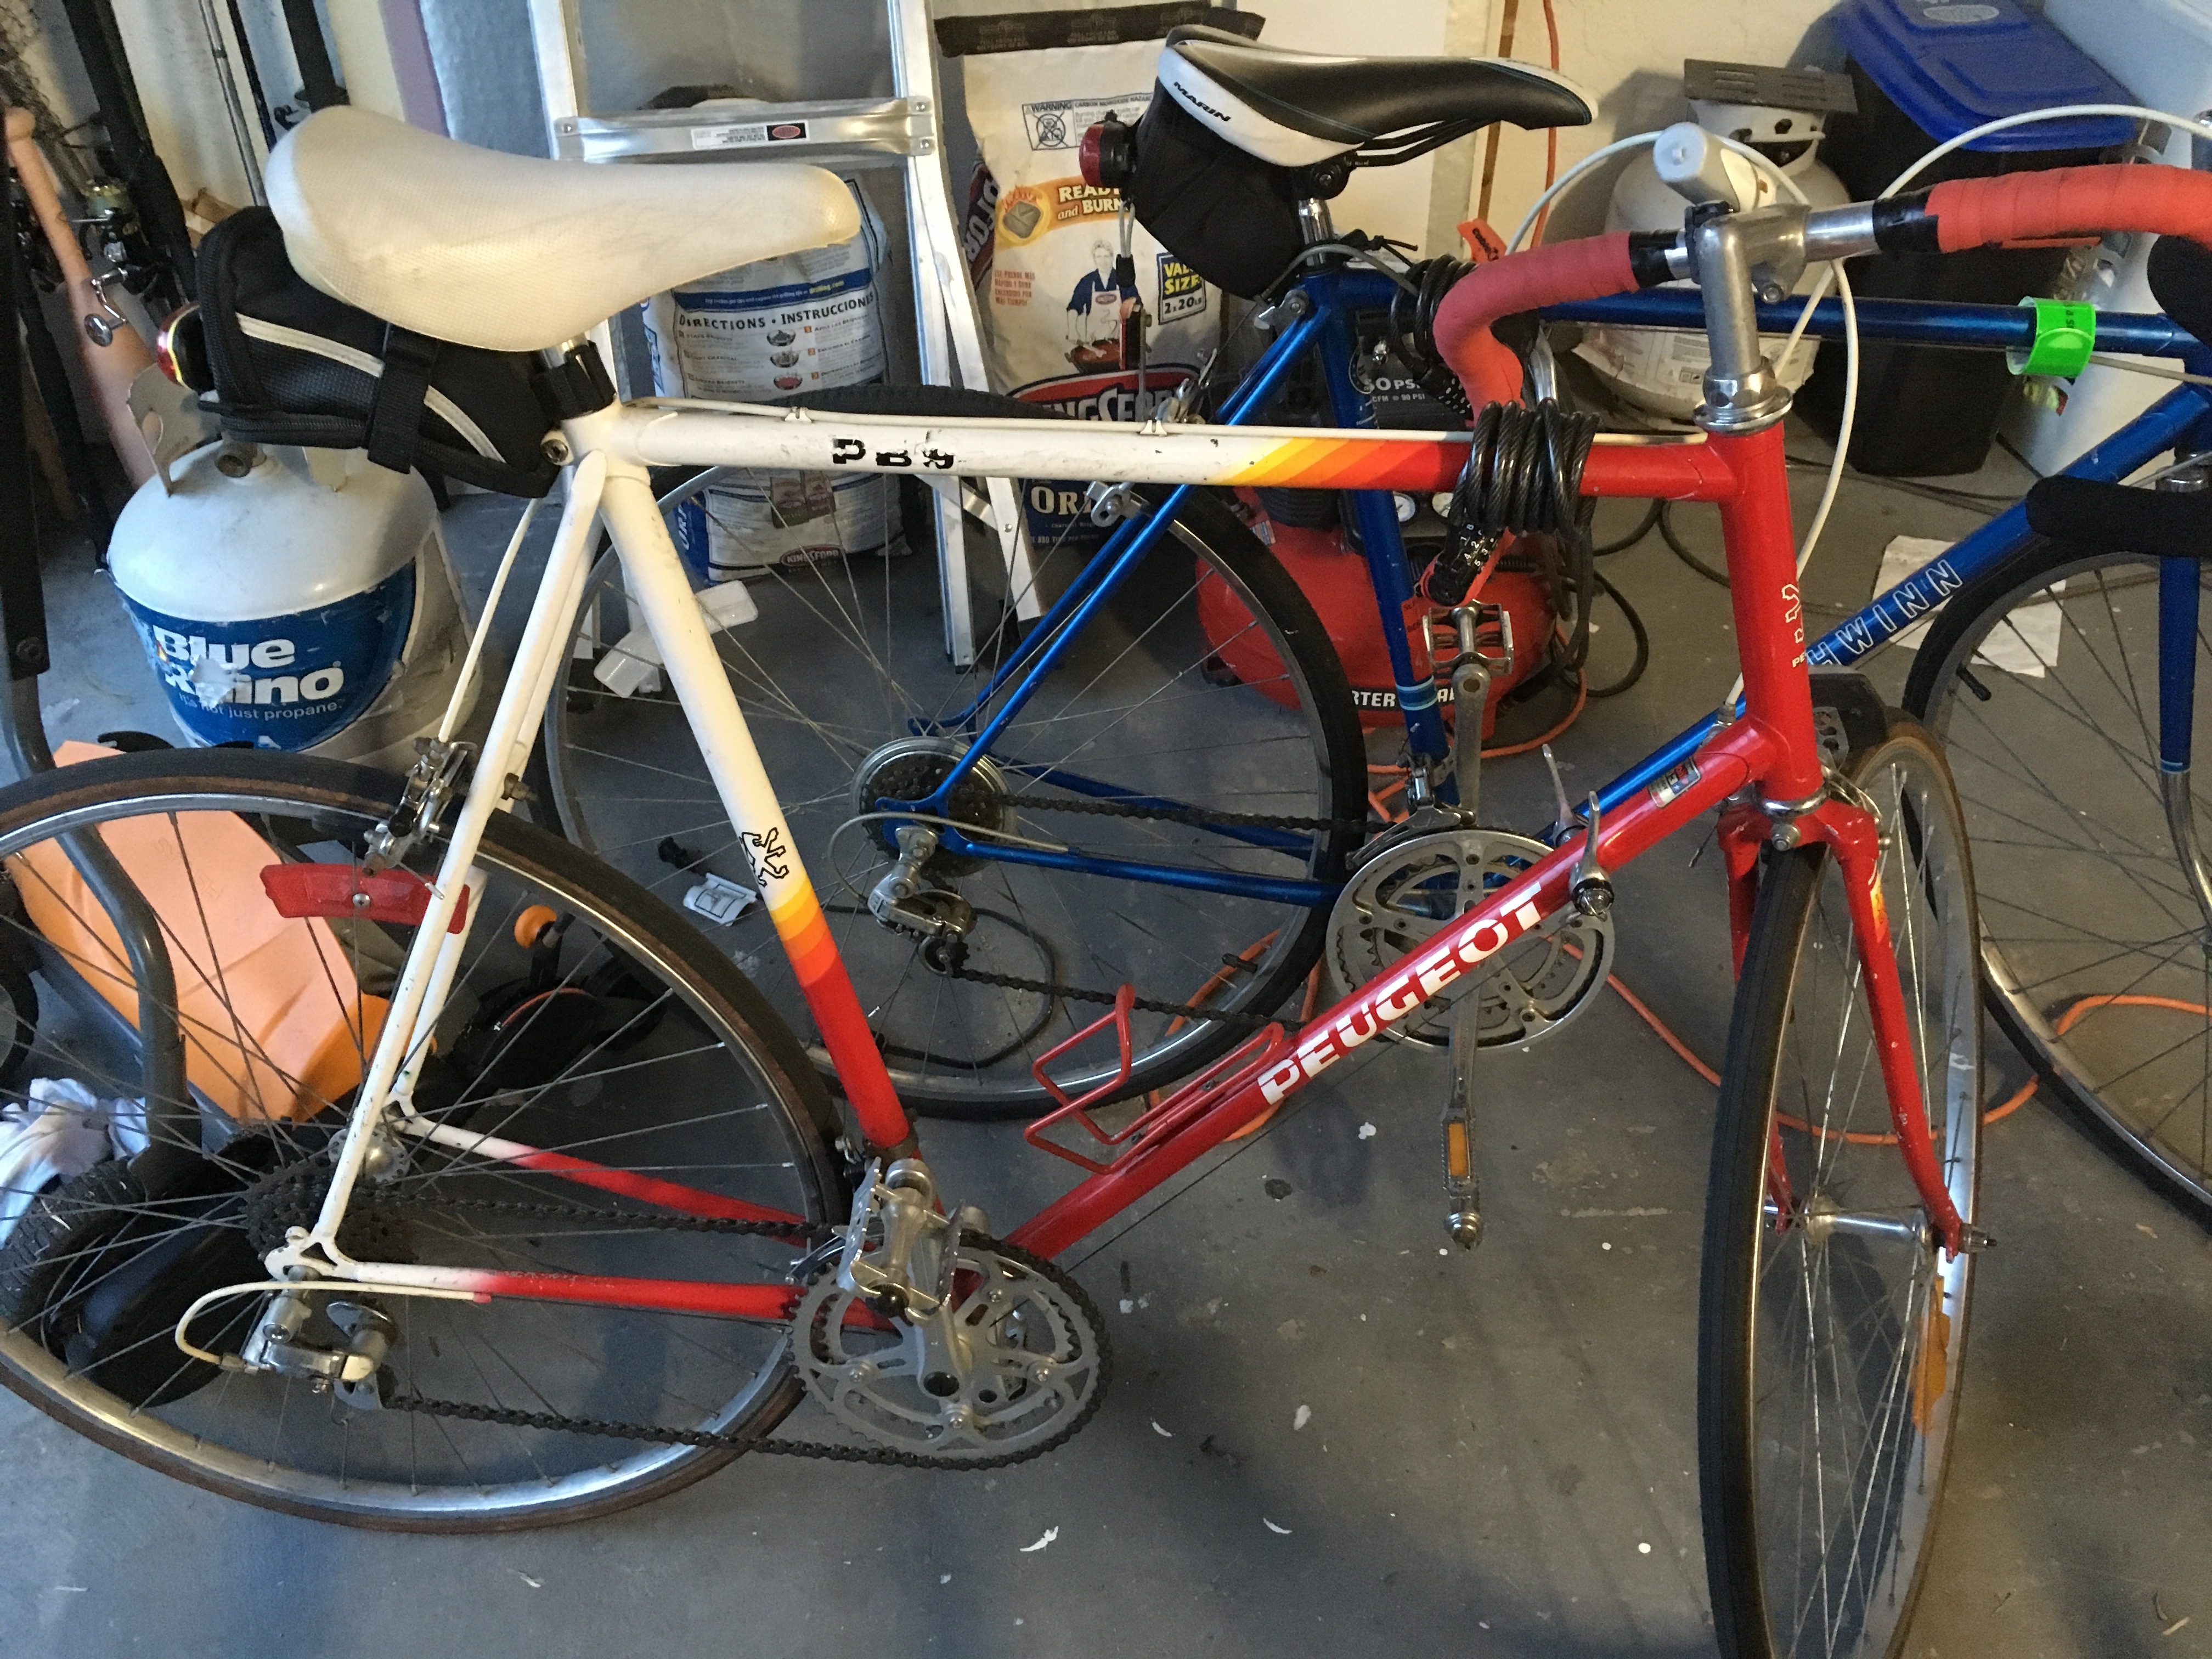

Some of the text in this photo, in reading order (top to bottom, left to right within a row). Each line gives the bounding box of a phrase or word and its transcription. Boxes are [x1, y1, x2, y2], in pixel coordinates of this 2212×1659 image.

[1031, 101, 1072, 110] WARNING
[1174, 82, 1231, 121] MARIN
[1059, 184, 1120, 202] READ
[1057, 205, 1078, 219] and
[1164, 262, 1194, 277] VAL
[1164, 274, 1201, 295] SIZE
[679, 293, 874, 330] DIRECTIONS INSTRUCCIONES
[153, 624, 295, 670] Blue
[165, 662, 345, 704] Rino
[229, 707, 259, 718] just
[1257, 881, 1542, 1105] PEUGEOT
